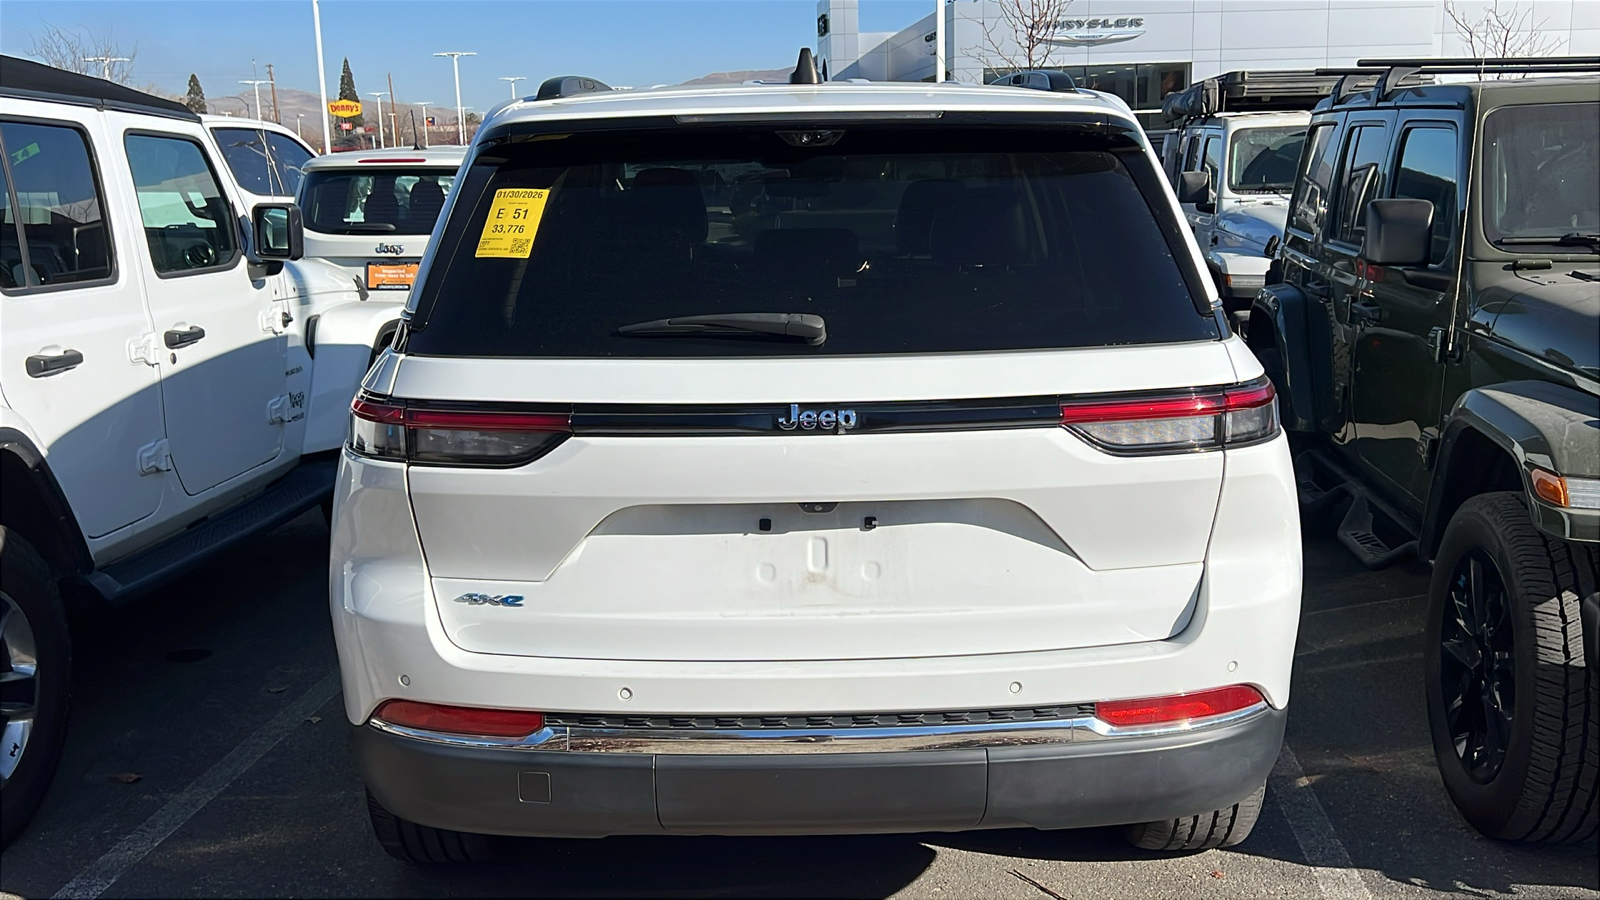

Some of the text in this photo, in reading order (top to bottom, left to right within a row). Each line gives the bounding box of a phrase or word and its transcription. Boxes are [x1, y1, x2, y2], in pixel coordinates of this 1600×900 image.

[330, 103, 359, 113] Denny's
[496, 190, 544, 199] 01/30/2026
[496, 208, 529, 220] E 51
[491, 224, 525, 235] 33,776
[375, 242, 404, 255] Jeep
[778, 403, 857, 435] Jeep
